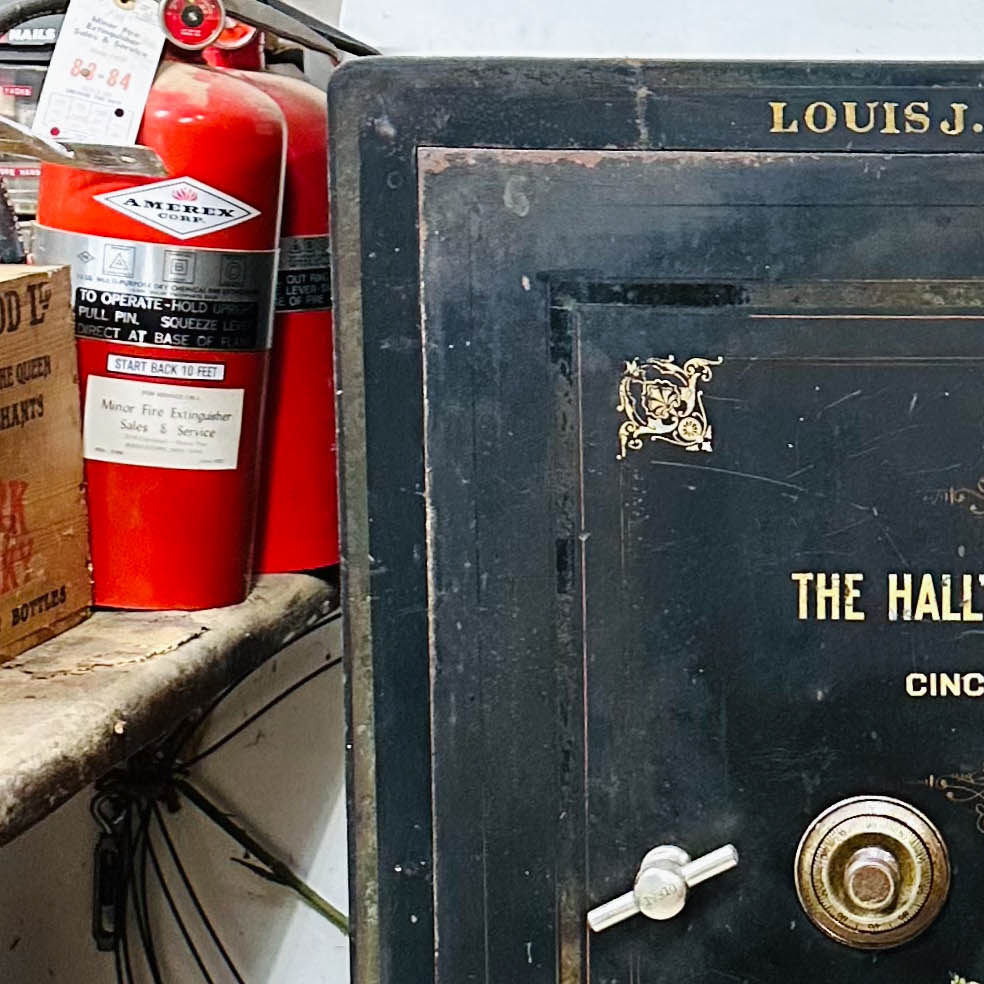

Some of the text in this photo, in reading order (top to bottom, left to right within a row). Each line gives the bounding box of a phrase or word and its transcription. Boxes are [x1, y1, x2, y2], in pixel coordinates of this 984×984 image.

[8, 28, 57, 41] NAILS
[769, 101, 931, 134] LOUIS
[940, 103, 984, 135] J.
[123, 198, 236, 217] AMEREX
[80, 289, 98, 302] TO
[78, 305, 109, 320] PULL
[160, 316, 218, 331] SQUEEZE
[77, 323, 121, 338] DIRECT
[128, 330, 147, 342] AT
[154, 332, 189, 346] BASE
[197, 335, 214, 347] OF
[114, 358, 219, 378] START BACK 10 FEET
[102, 399, 233, 423] Minor Fire Extinguisher
[120, 418, 148, 432] Sales
[177, 425, 217, 438] Service
[12, 585, 67, 626] BOTTLES
[791, 573, 865, 620] THE
